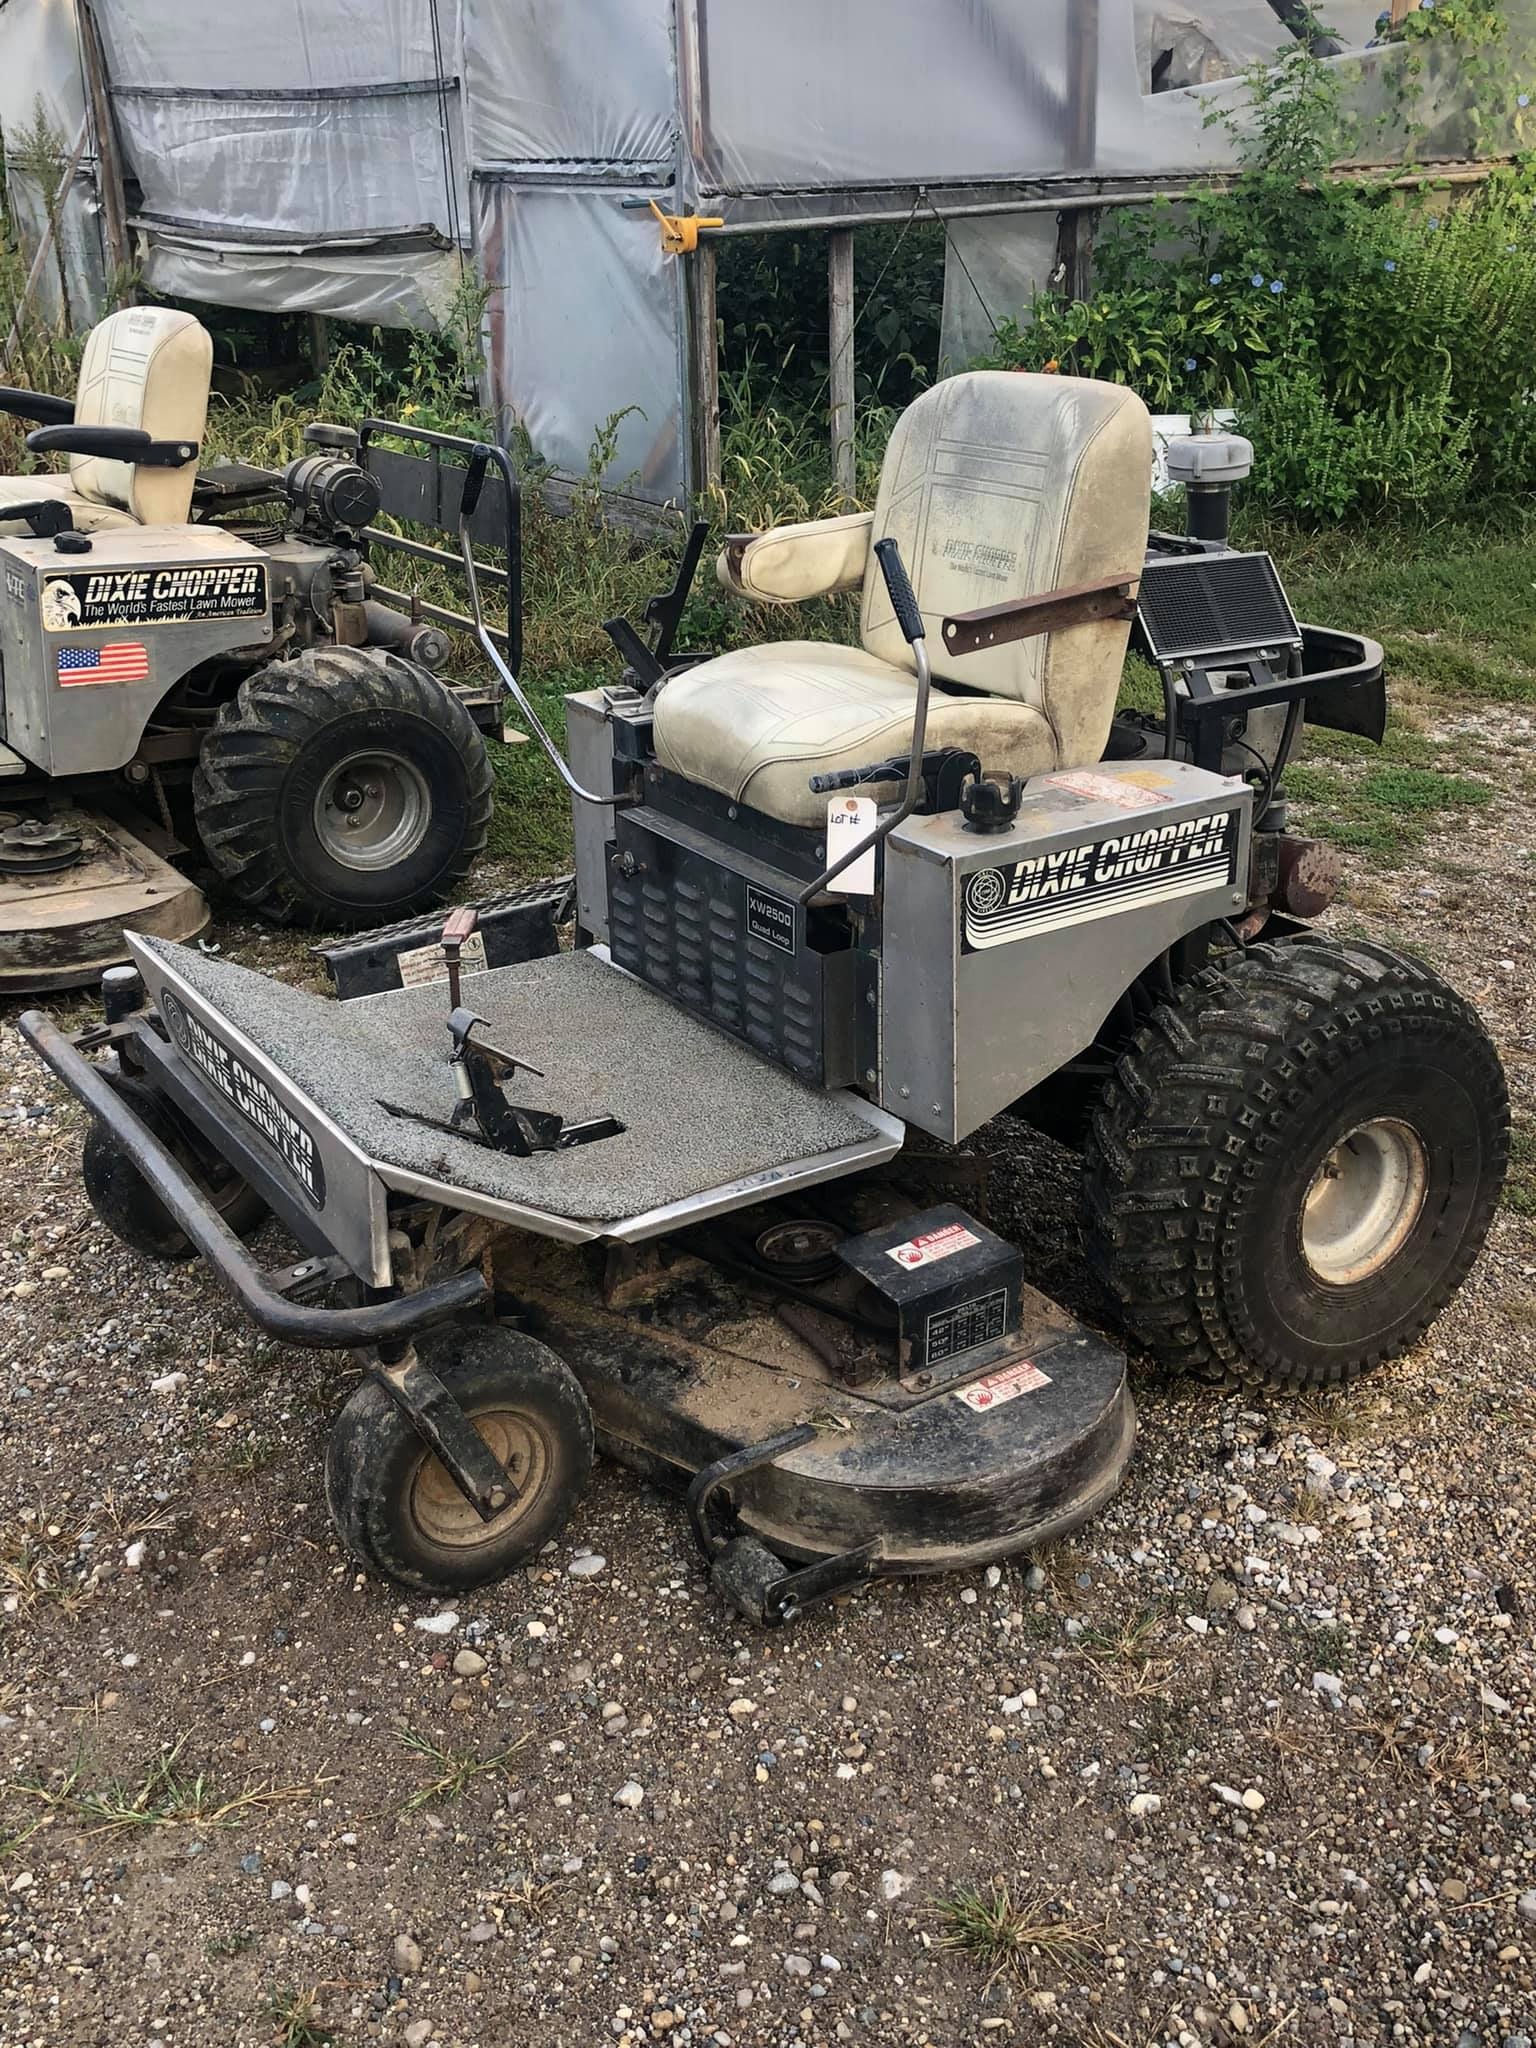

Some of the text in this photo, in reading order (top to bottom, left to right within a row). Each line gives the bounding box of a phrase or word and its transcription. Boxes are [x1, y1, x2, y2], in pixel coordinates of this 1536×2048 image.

[84, 567, 259, 604] DIXIE CHOPPER
[84, 595, 256, 617] The World's Fastest Lawn Mower
[830, 813, 848, 825] LOT
[1008, 812, 1230, 905] DIXIE CHOPPER
[749, 896, 792, 927] XW2500
[752, 920, 790, 946] Quad Loop
[186, 1012, 314, 1191] DIXIE CHOPPER
[925, 1225, 962, 1242] DANGER
[995, 1363, 1032, 1380] DANGER
